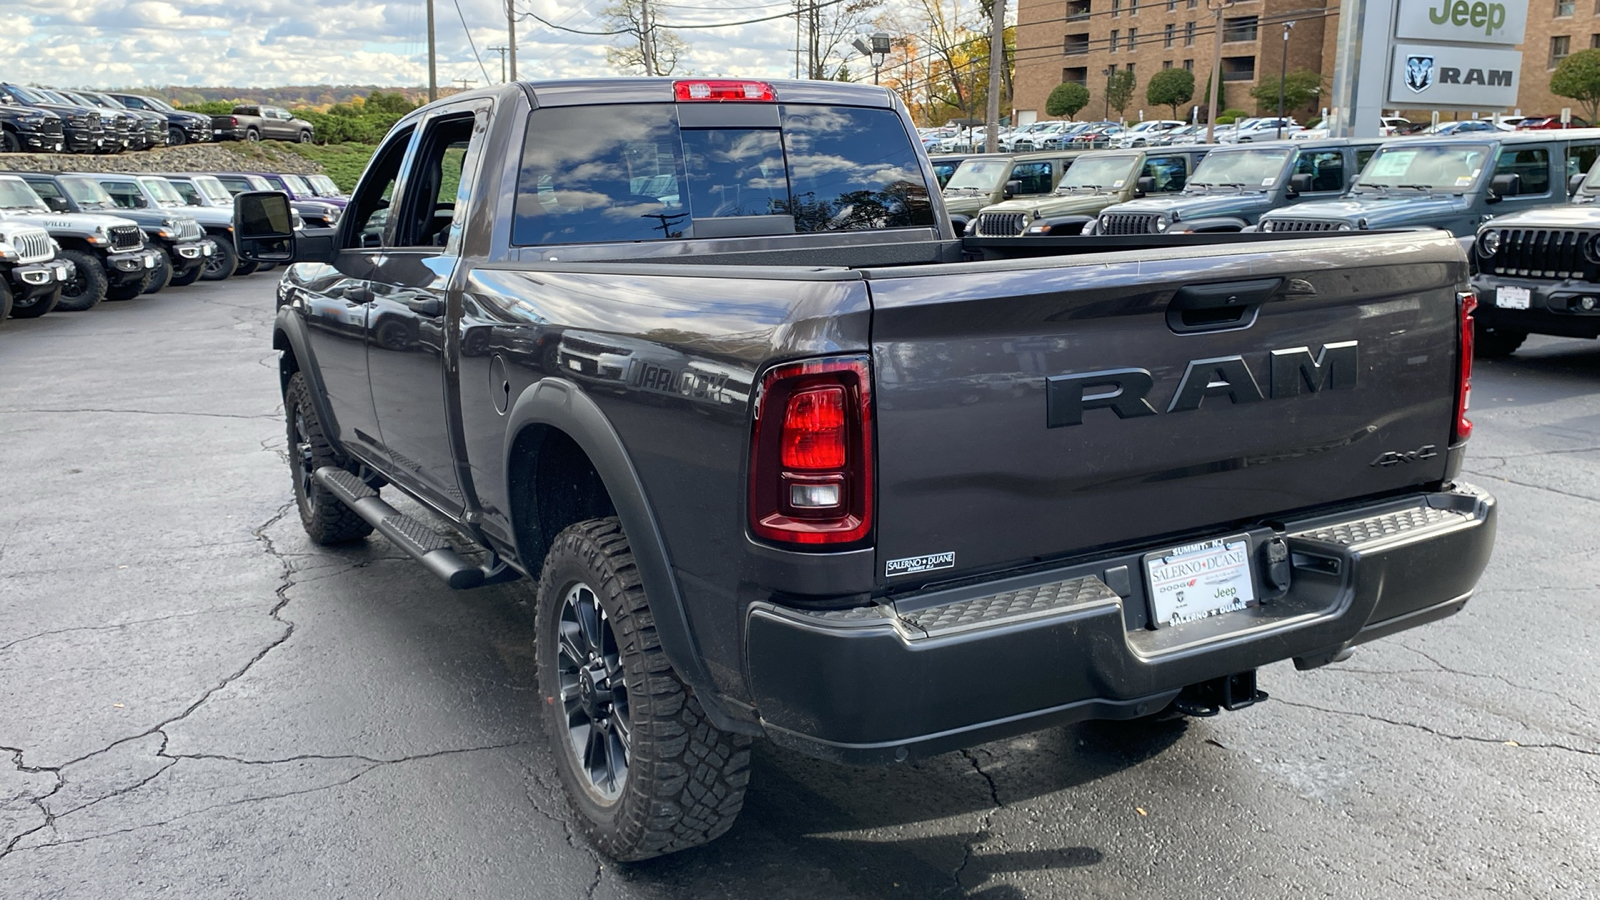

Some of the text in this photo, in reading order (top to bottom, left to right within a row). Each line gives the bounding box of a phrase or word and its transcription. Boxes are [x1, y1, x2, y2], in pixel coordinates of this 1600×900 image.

[1429, 0, 1506, 36] Jeep
[1439, 67, 1513, 87] RAM
[626, 358, 729, 405] WARLOCK
[1046, 340, 1358, 428] RAM
[1212, 539, 1224, 548] NJ
[888, 558, 921, 571] SALERNO
[927, 554, 953, 565] DUANE
[1152, 561, 1202, 583] SALERNO
[1206, 551, 1245, 570] DUANE
[1214, 587, 1237, 599] Jeep
[1169, 601, 1247, 627] SALERNO DUANE
